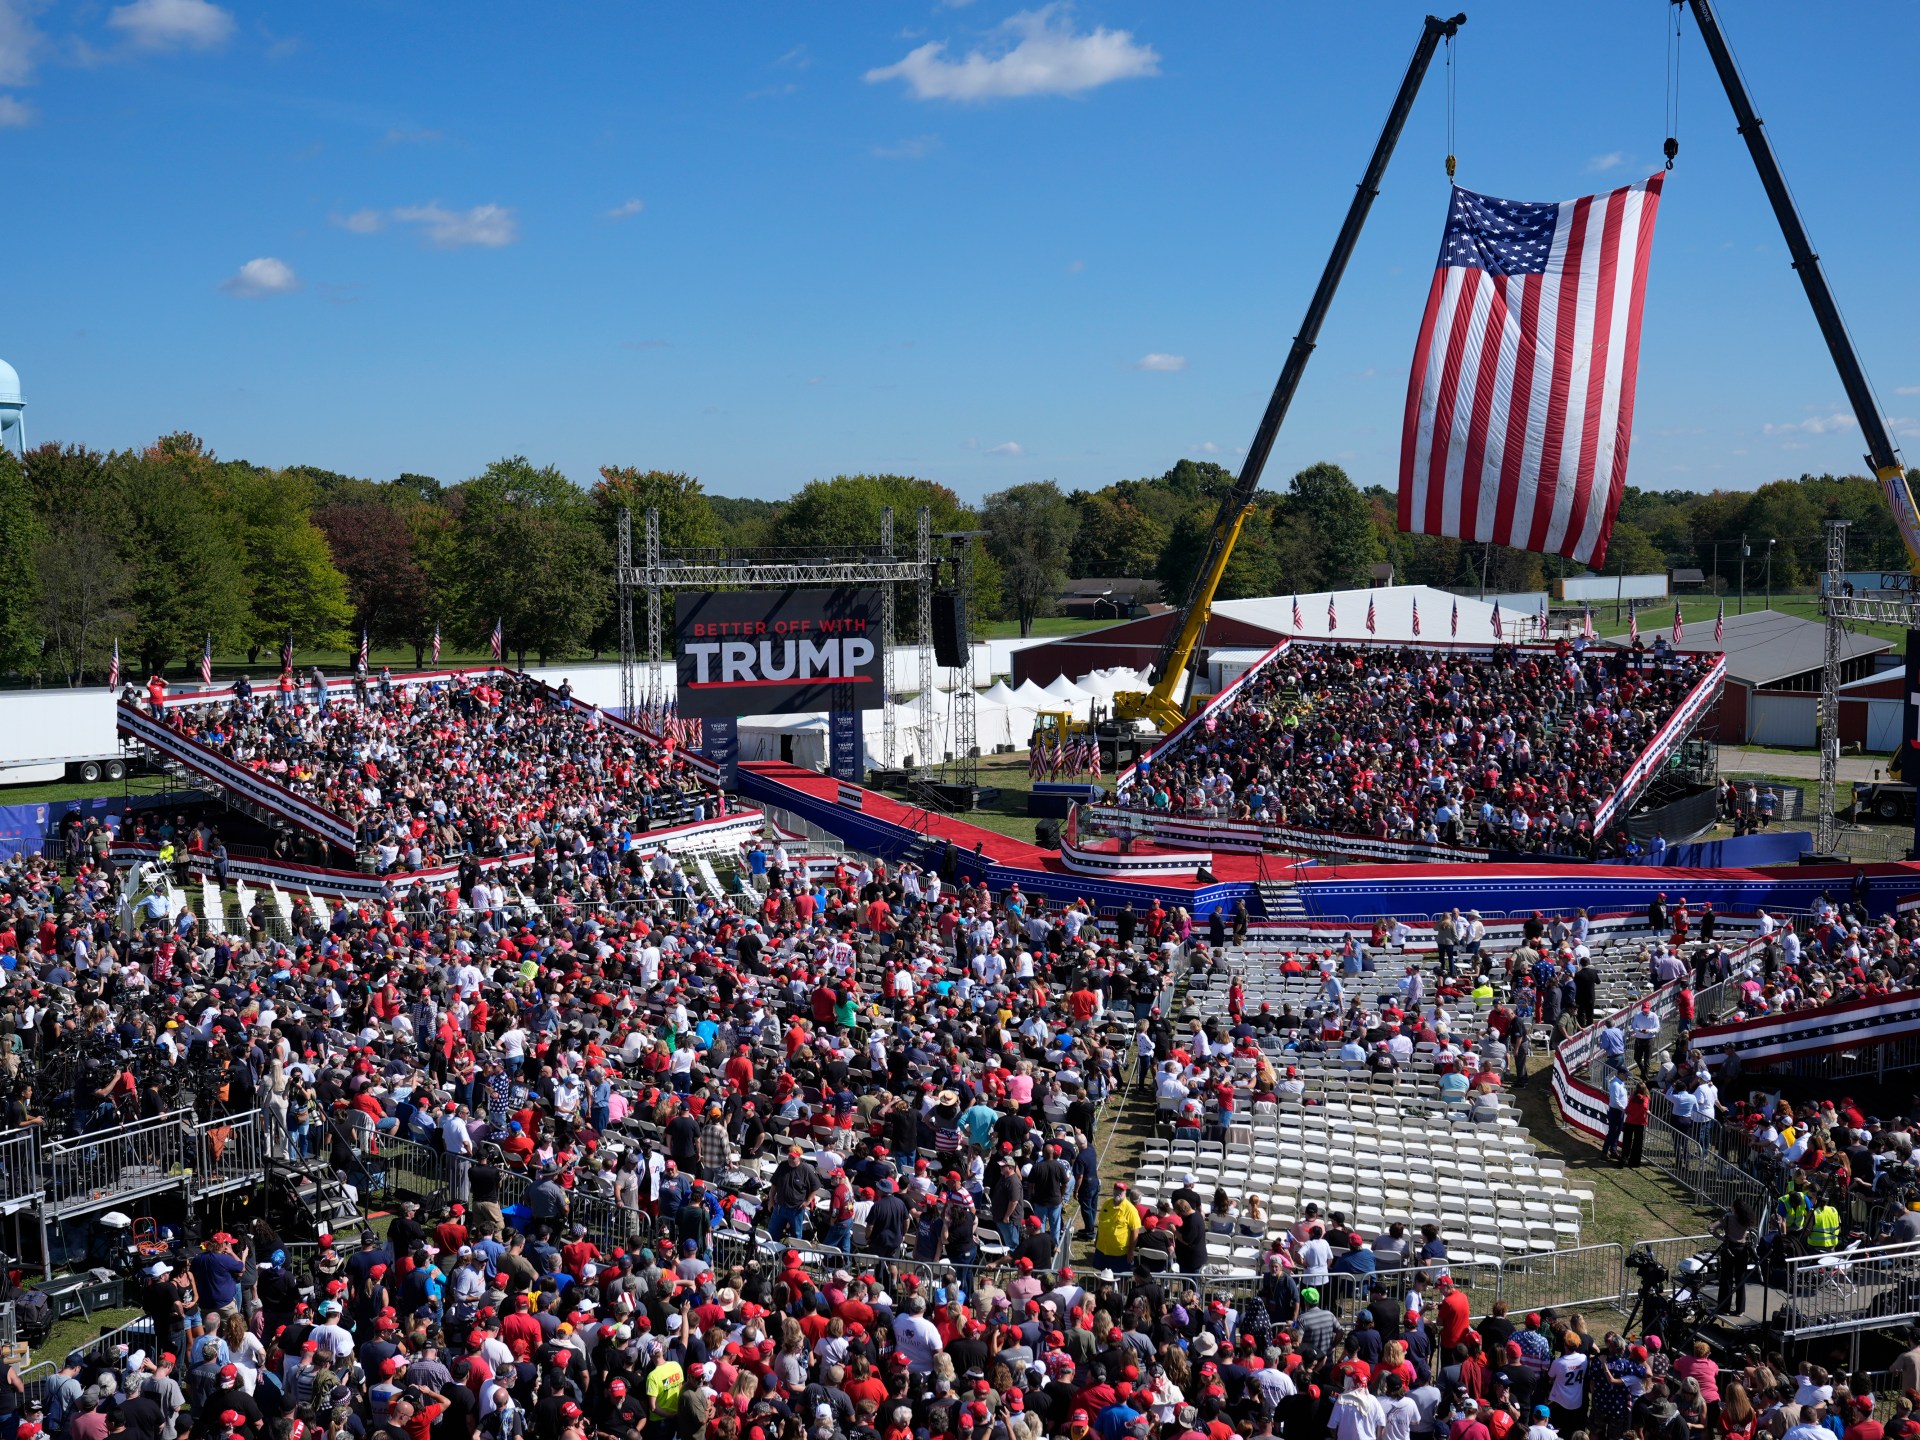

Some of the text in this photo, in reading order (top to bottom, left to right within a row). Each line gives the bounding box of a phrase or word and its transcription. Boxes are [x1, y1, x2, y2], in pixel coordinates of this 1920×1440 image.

[694, 618, 866, 637] BETTER OFF WITH
[684, 637, 875, 684] TRUMP
[836, 952, 847, 962] 47
[1564, 1370, 1584, 1386] 24
